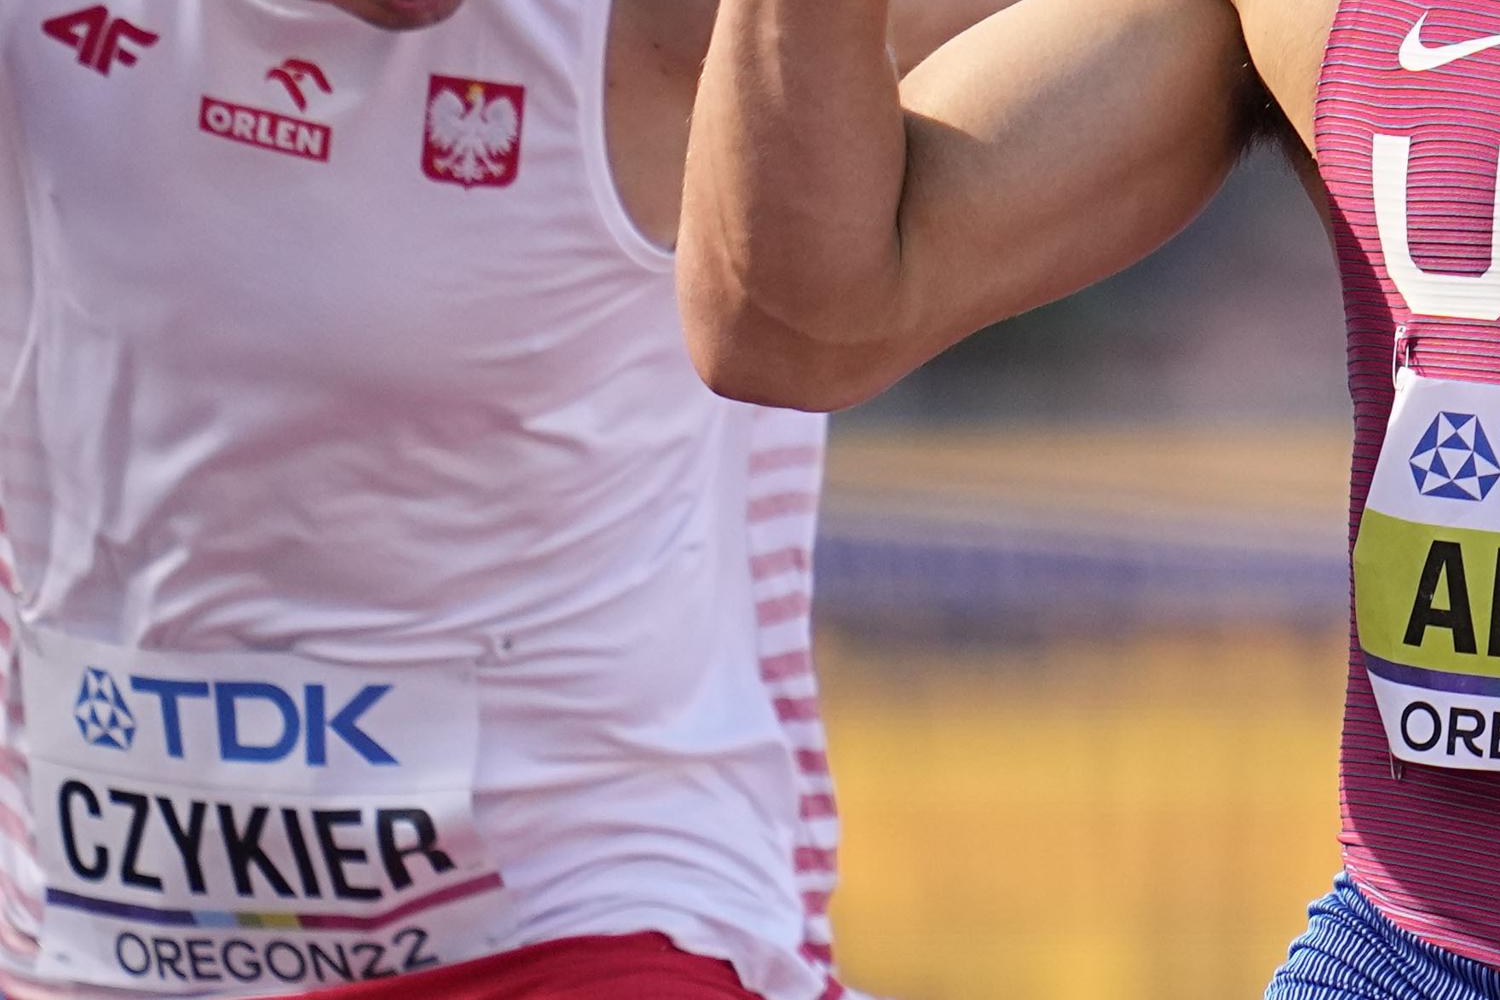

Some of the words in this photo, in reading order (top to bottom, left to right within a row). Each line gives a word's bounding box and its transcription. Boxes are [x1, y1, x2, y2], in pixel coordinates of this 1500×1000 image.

[42, 4, 159, 77] 4F
[207, 106, 323, 154] ORLEN
[131, 675, 399, 766] TDK
[58, 779, 455, 900] CZYKIER
[116, 926, 438, 982] OREGON22
